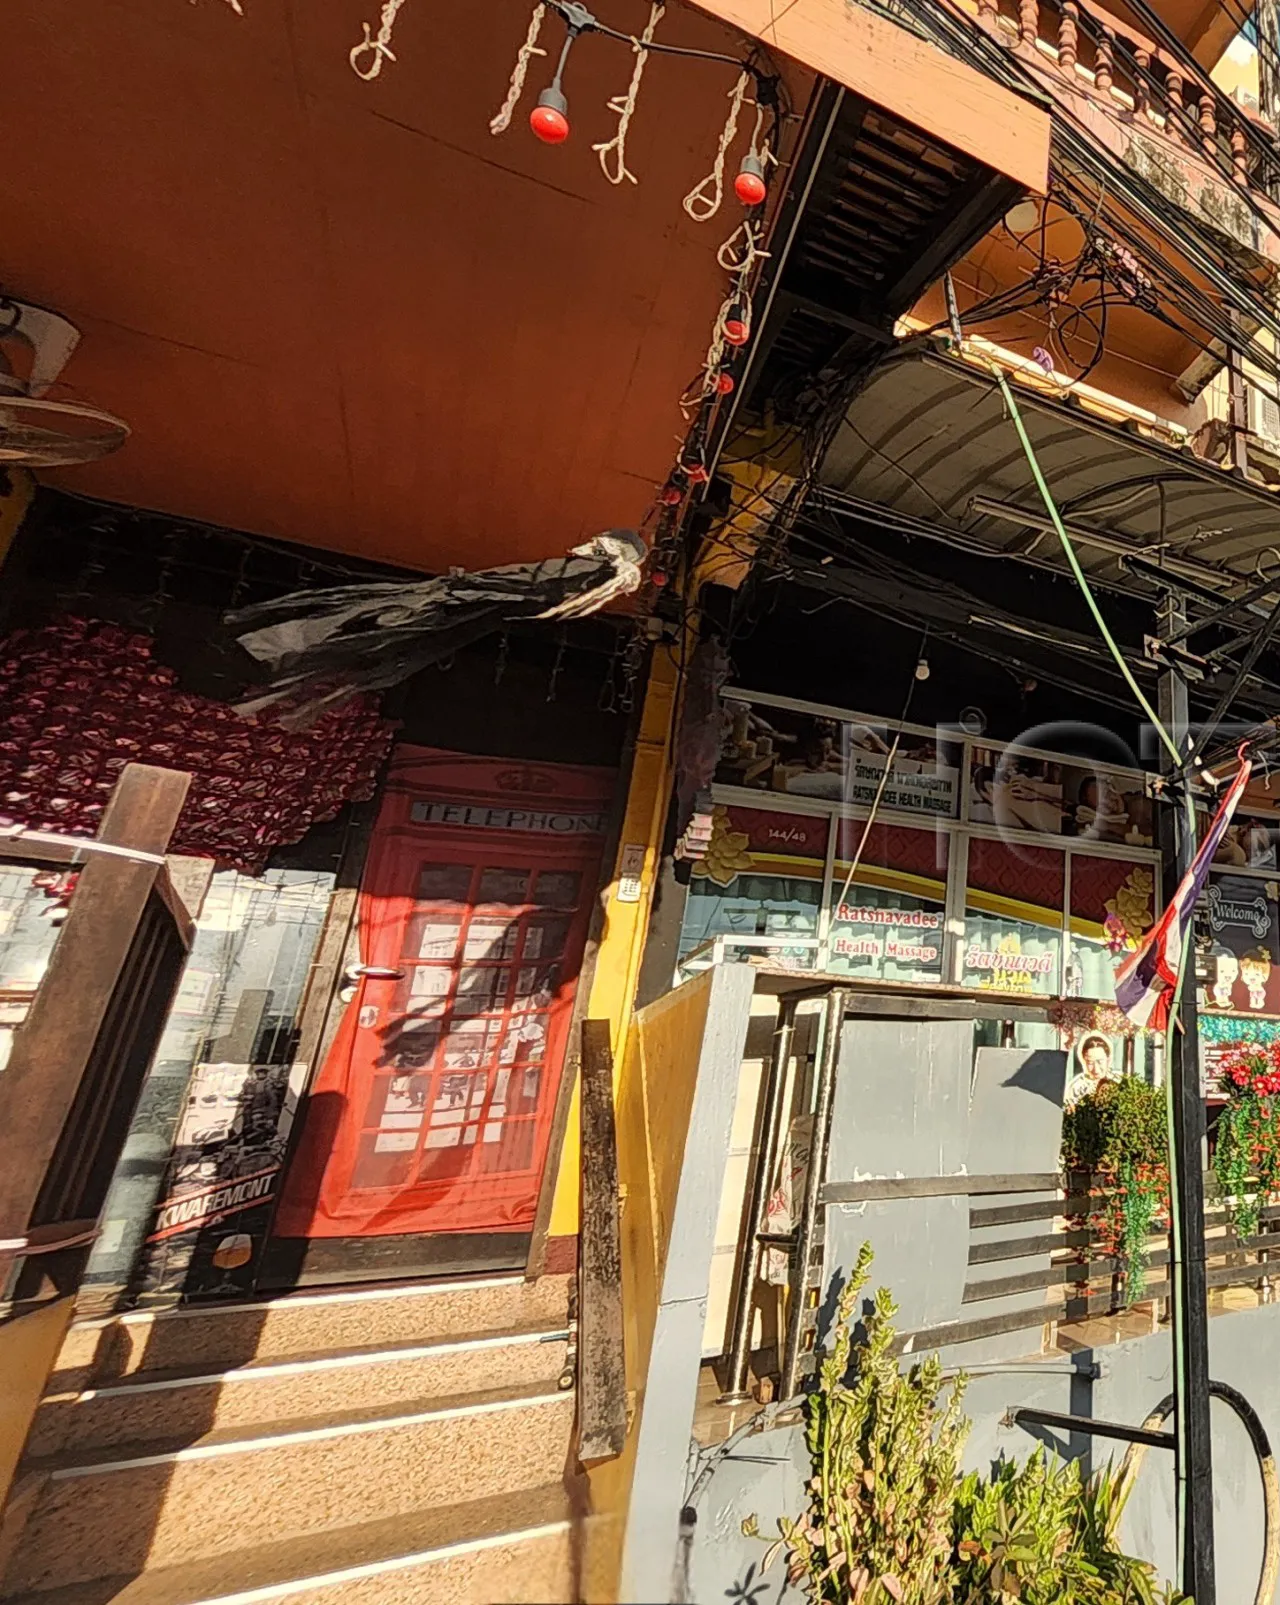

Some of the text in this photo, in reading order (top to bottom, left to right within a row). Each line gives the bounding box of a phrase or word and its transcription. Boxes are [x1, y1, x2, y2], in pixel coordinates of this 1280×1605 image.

[898, 791, 922, 809] HEALTH
[922, 796, 953, 815] MASSAGE
[768, 827, 806, 842] 144/48
[837, 903, 939, 928] Ratsnavadee
[1215, 903, 1261, 921] Welcome
[835, 938, 938, 961] Health Massage
[154, 1173, 276, 1232] KWAREMONT
